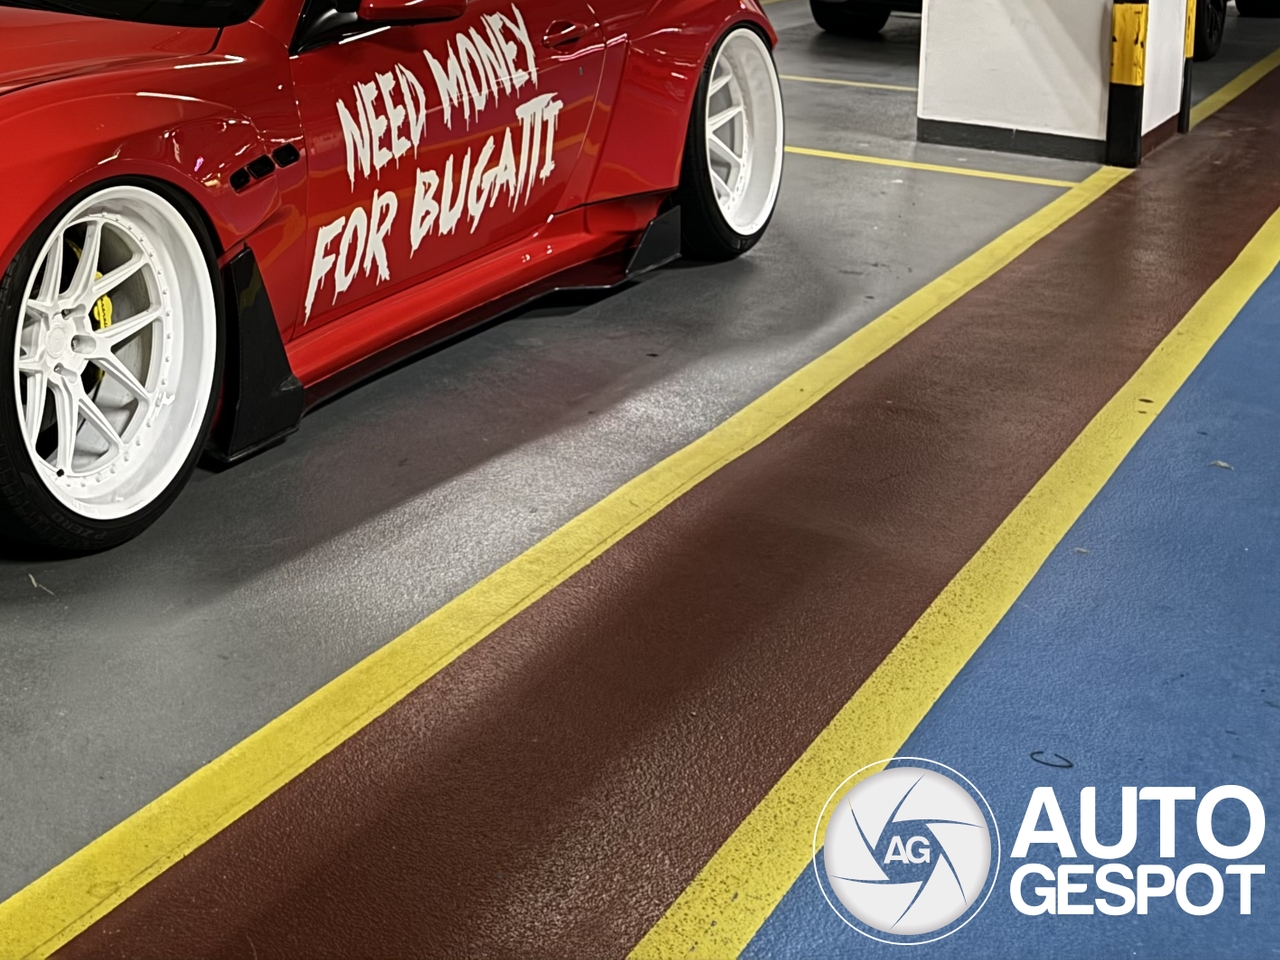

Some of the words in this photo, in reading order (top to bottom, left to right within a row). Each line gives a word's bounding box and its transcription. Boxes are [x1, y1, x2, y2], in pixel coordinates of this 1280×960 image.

[336, 62, 427, 193] NEED
[422, 2, 538, 131] MONEY
[304, 189, 398, 326] FOR
[409, 92, 564, 259] BUGATTI
